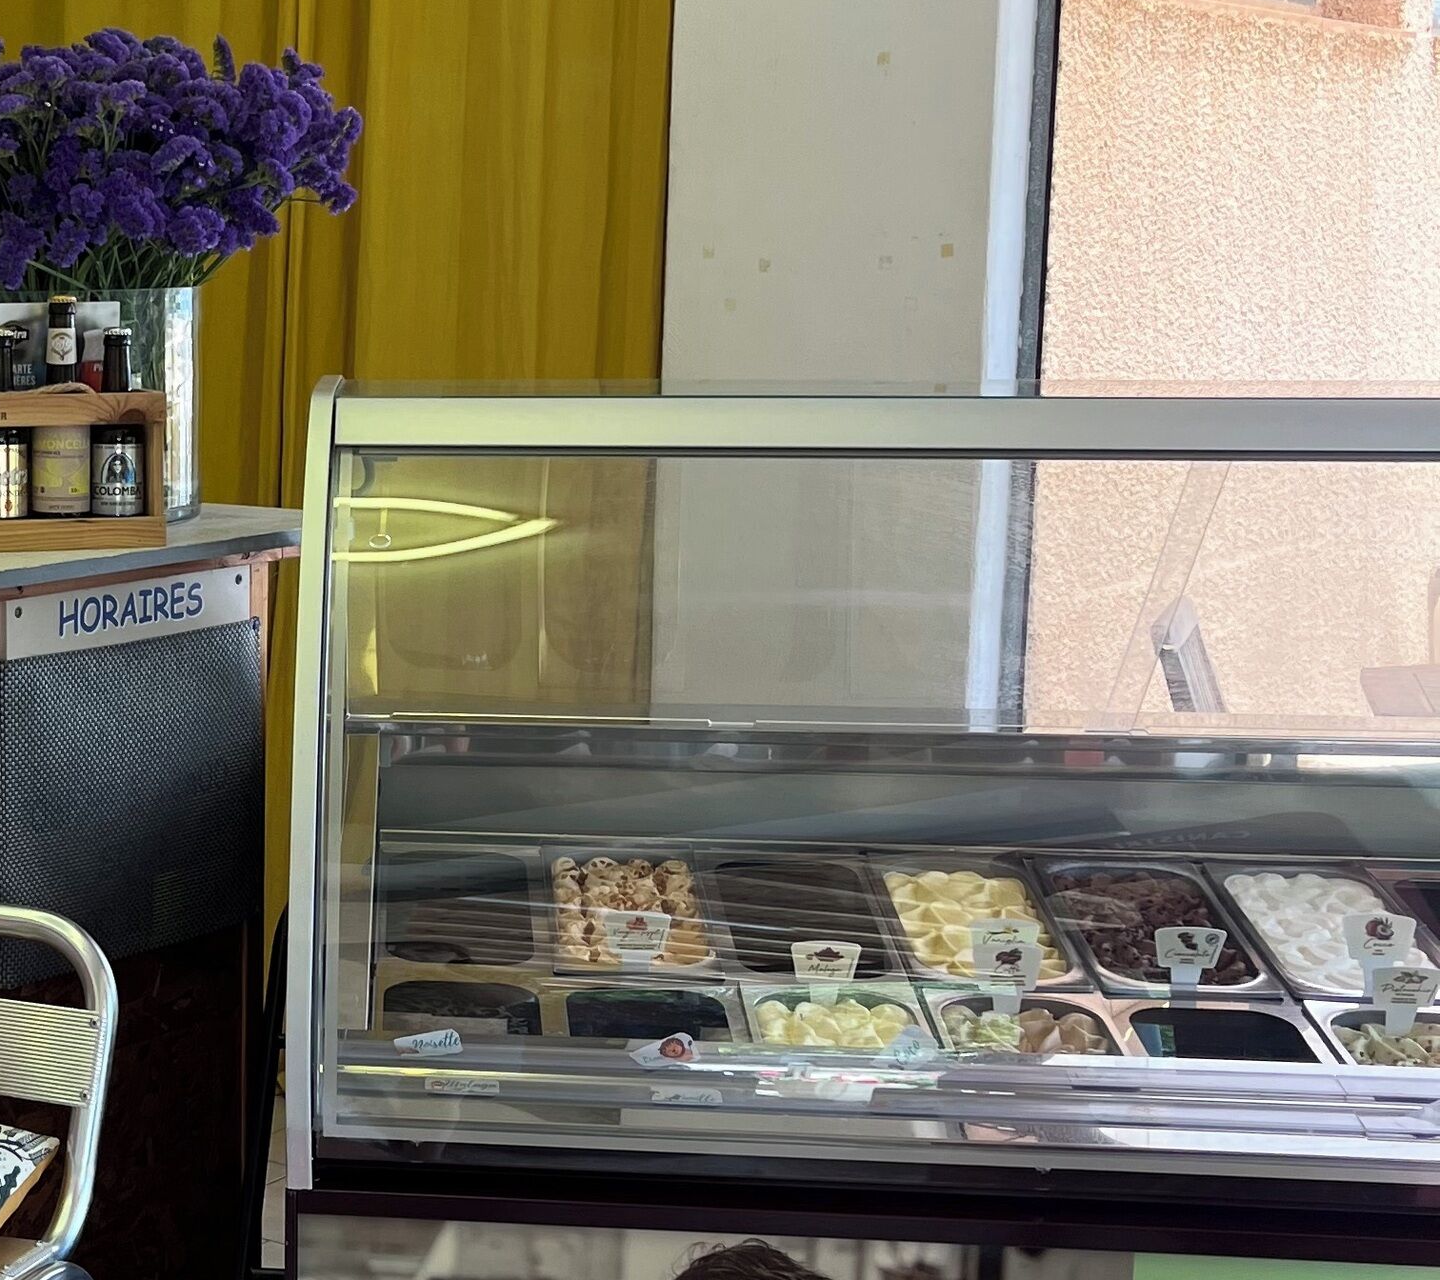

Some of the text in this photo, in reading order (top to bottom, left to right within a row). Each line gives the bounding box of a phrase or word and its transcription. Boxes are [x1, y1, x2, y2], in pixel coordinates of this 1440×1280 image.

[94, 485, 142, 497] COLOMBA
[59, 582, 203, 637] HORAIRES
[412, 1031, 460, 1050] Noisette
